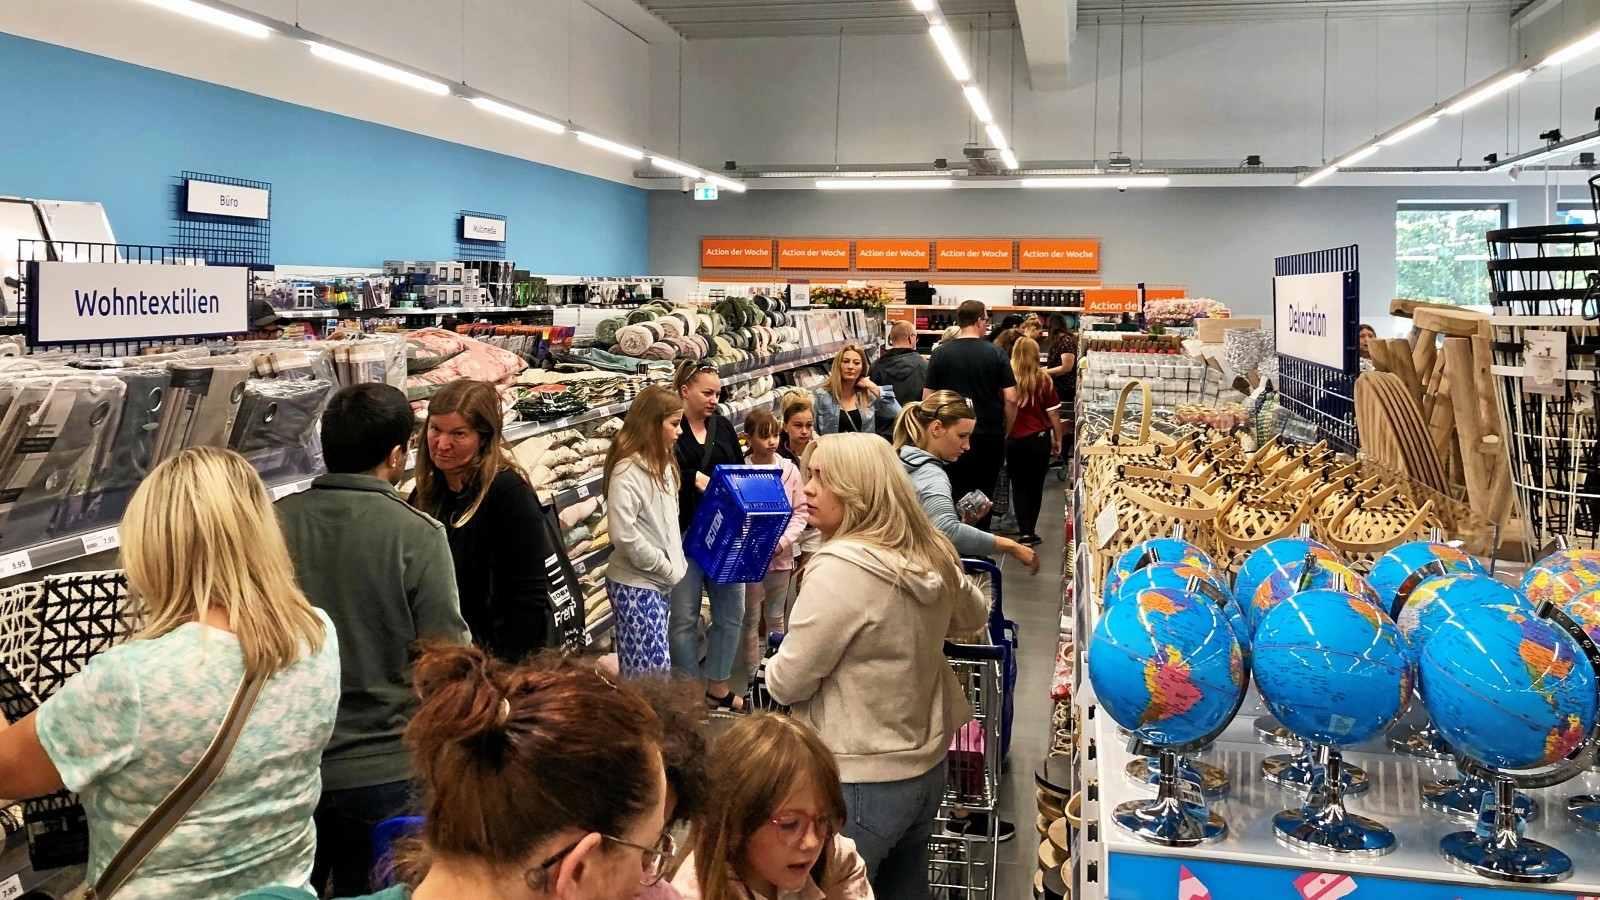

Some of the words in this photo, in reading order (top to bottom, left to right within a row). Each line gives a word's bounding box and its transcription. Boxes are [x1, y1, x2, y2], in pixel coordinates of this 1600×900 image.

[220, 195, 239, 207] Büro
[473, 225, 497, 235] Multimedia
[706, 248, 728, 256] Action
[731, 248, 741, 256] der
[744, 248, 769, 256] Woche
[782, 249, 805, 257] Action
[807, 249, 819, 257] der
[821, 249, 846, 257] Woche
[940, 250, 965, 258] Action
[967, 250, 979, 258] der
[982, 250, 1009, 258] Woche
[1023, 250, 1049, 258] Action
[1051, 250, 1064, 258] der
[1066, 250, 1094, 258] Woche
[74, 287, 220, 317] Wohntextilien
[1089, 301, 1122, 311] Action
[1124, 301, 1138, 311] de
[1289, 301, 1327, 338] Dekoration
[103, 536, 116, 545] 7.95
[11, 560, 26, 570] 8.95
